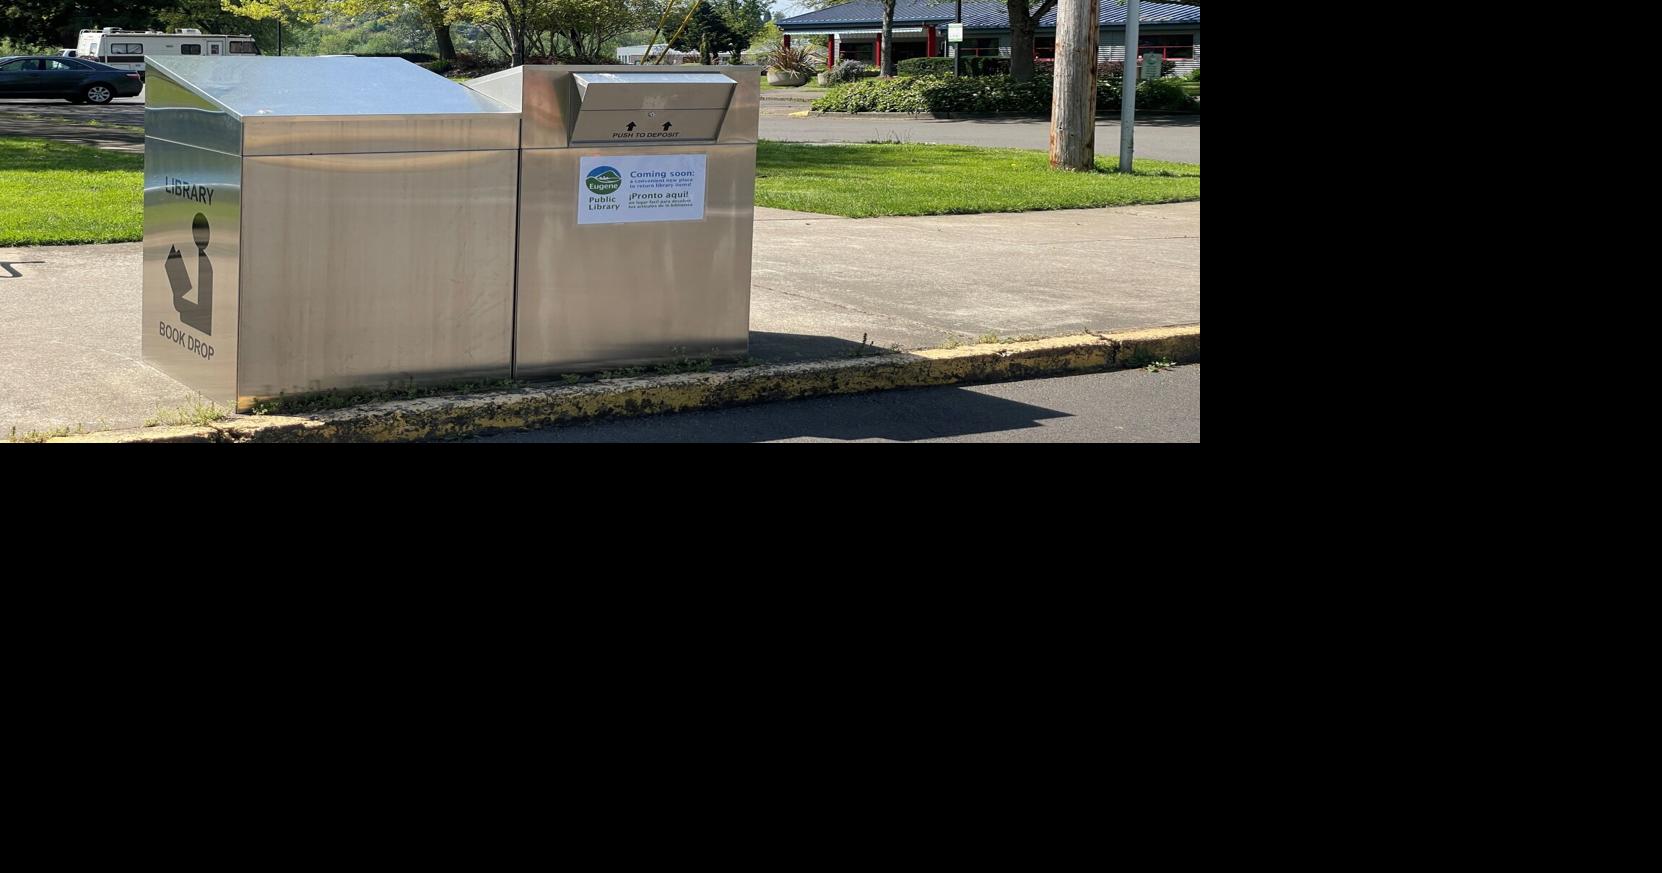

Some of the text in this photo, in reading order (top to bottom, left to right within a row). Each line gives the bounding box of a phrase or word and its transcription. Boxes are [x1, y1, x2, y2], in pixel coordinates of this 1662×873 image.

[630, 170, 666, 178] Coming
[165, 176, 214, 206] LIBRARY
[629, 192, 663, 201] ¡Pronto
[159, 320, 215, 360] BOOK DROP
